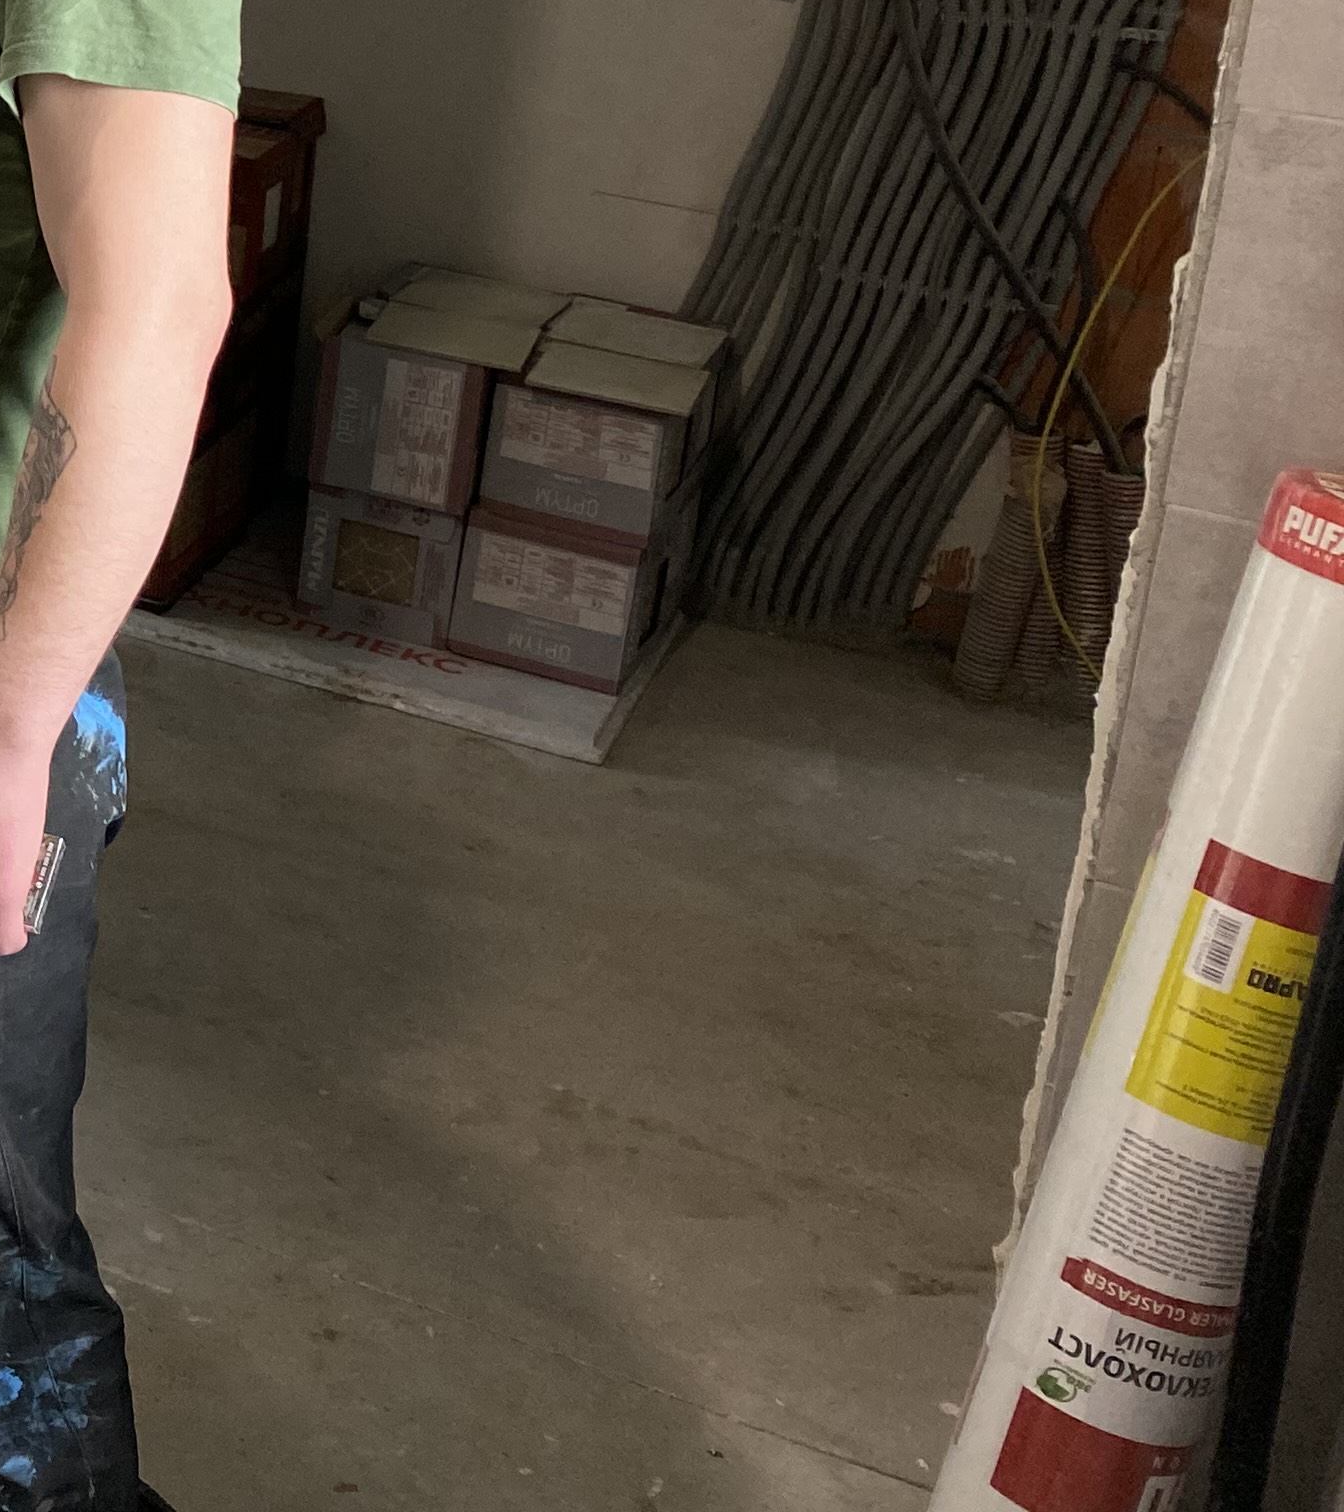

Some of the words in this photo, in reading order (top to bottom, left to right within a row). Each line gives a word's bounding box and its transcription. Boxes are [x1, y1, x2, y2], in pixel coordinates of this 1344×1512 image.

[180, 589, 468, 675] ХНОПЛЕКС
[1082, 1268, 1185, 1322] GLASFASER
[1048, 1326, 1213, 1399] ЕКЛОХОЛСТ
[1115, 1328, 1218, 1370] ЛЯРНЫЙ
